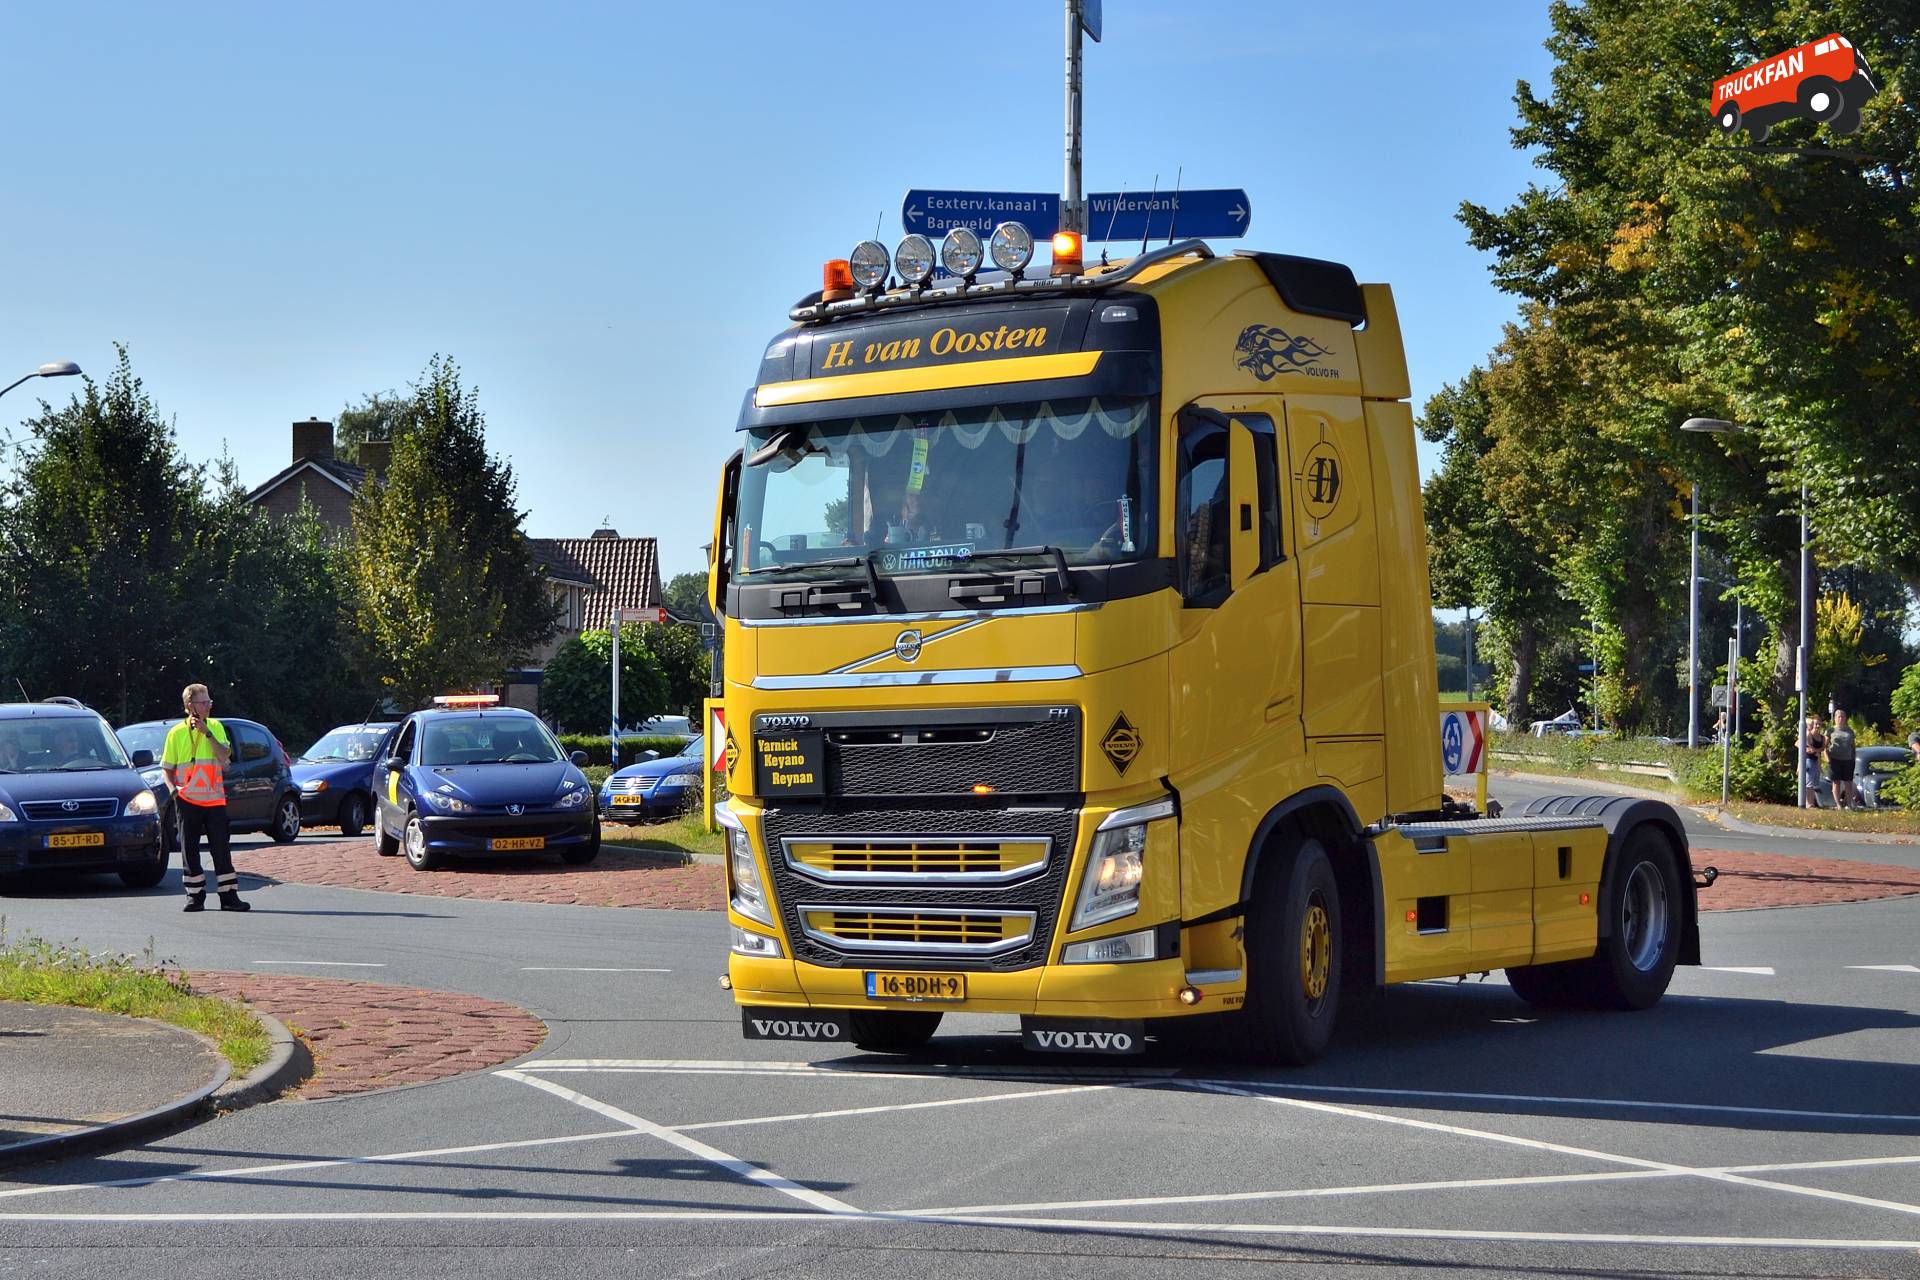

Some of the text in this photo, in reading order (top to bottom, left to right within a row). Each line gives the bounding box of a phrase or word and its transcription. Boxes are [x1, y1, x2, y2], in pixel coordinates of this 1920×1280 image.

[927, 196, 1048, 212] Eexterv.kanaal 1
[1092, 197, 1180, 212] Wildervank
[927, 216, 992, 230] Bareveld
[821, 325, 1048, 369] H. van Oosten
[1304, 366, 1340, 379] VOLVO FH
[760, 715, 811, 727] VOLVO
[1049, 708, 1069, 719] FH
[757, 738, 799, 753] Yarnick
[763, 753, 805, 769] Keyano
[772, 771, 814, 788] Reynan
[52, 834, 100, 846] 85-JT-RD
[494, 838, 543, 849] 02-HR-VZ
[881, 975, 958, 995] 16-BDH-9
[751, 1019, 840, 1038] VOLVO
[1032, 1030, 1132, 1050] VOLVO
